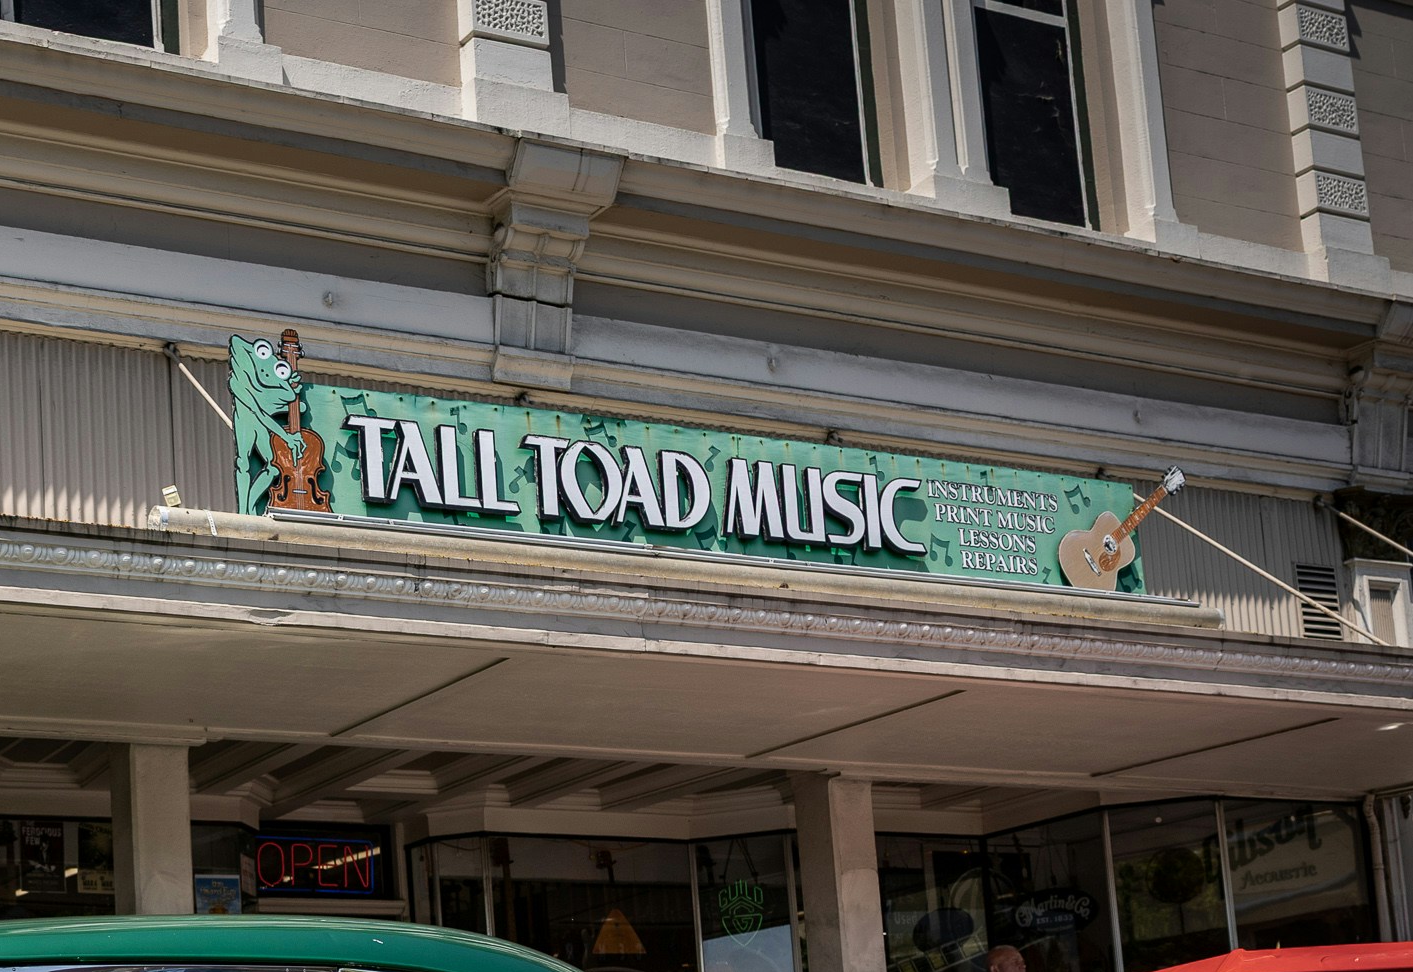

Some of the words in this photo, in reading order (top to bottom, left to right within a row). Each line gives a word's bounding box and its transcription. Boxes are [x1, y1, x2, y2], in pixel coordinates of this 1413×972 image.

[340, 414, 521, 516] TALL
[518, 433, 711, 532] TOAD
[721, 457, 927, 556] MUSIC
[926, 478, 1059, 513] INSTRUMENTS
[934, 502, 994, 525] PRINT
[996, 511, 1056, 534] MUSIC
[958, 527, 1037, 554] LESSONS
[960, 550, 1039, 576] REPAIRS
[256, 841, 370, 889] OPEN
[718, 879, 764, 909] GUILD
